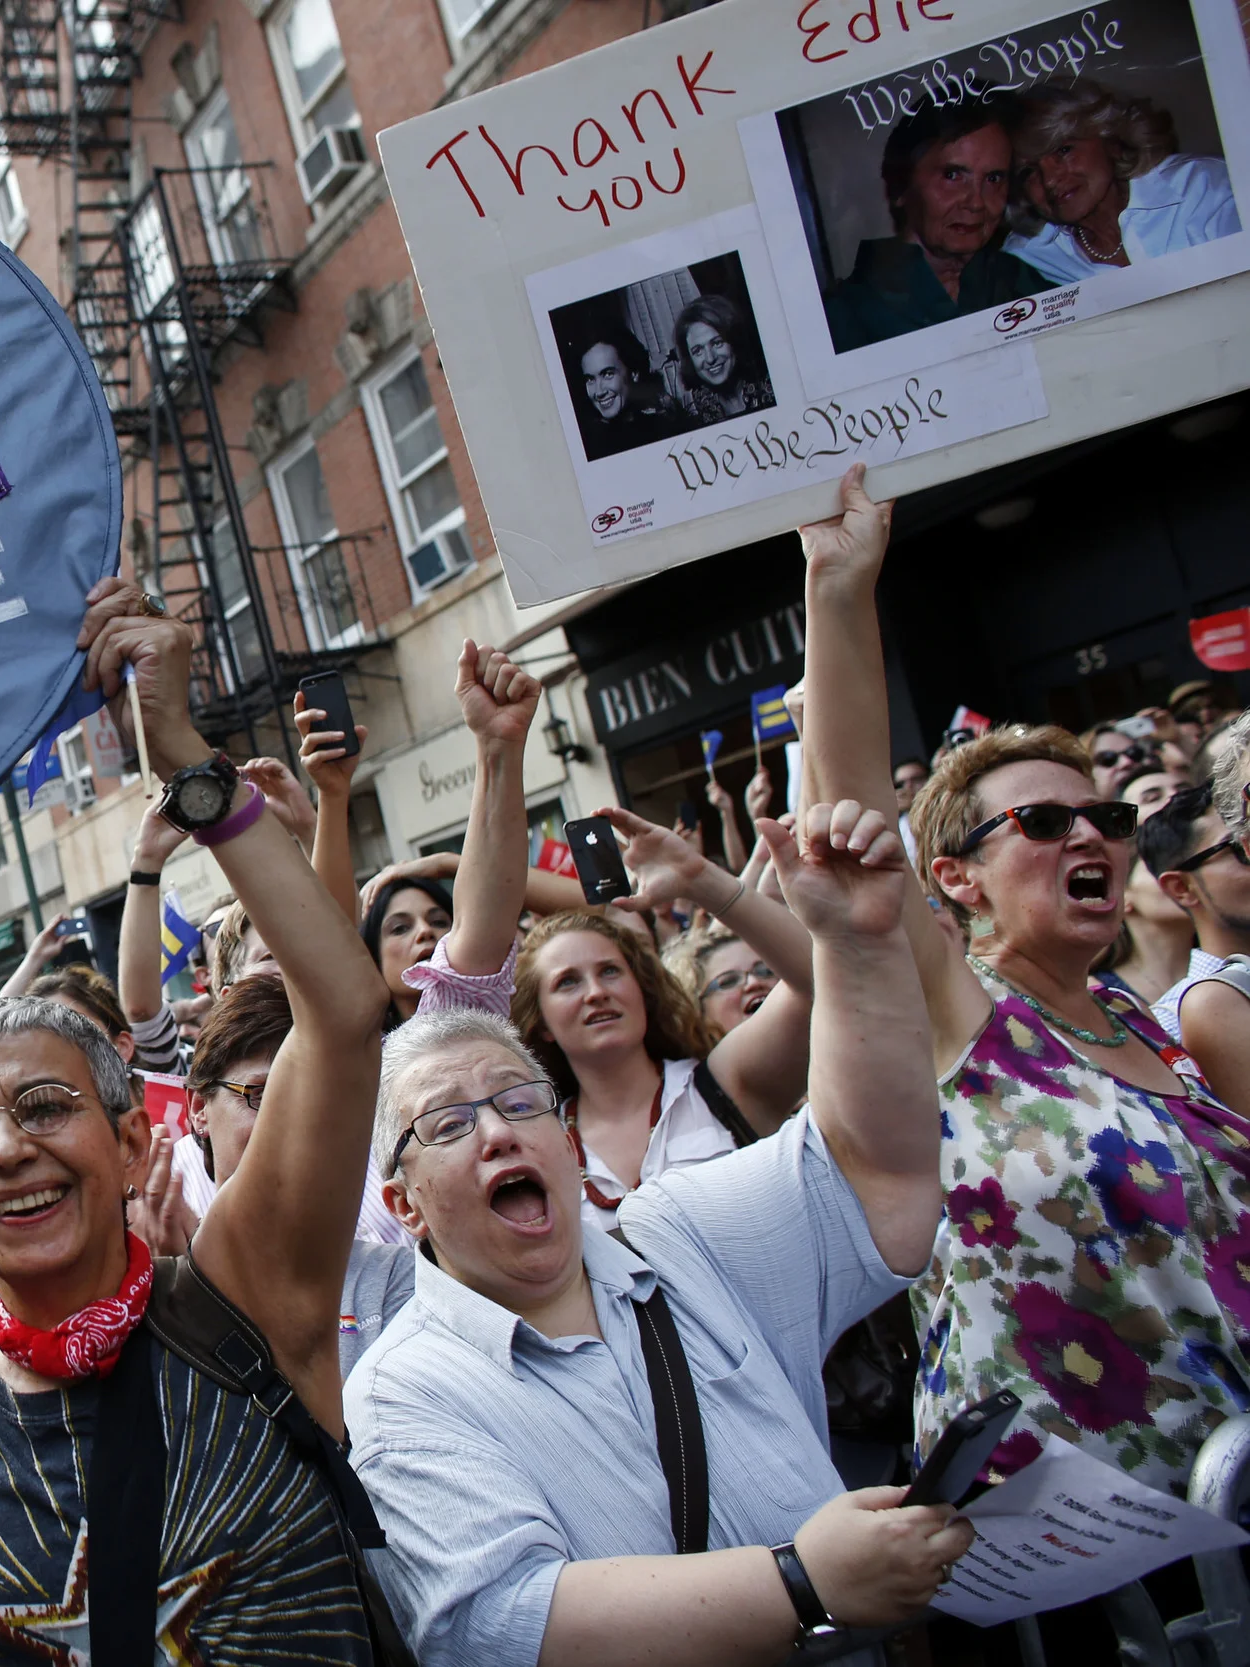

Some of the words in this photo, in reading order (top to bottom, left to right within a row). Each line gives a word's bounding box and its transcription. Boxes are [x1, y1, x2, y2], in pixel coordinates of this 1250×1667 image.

[842, 75, 924, 139] We
[920, 59, 988, 111] the
[979, 11, 1124, 105] People
[426, 51, 736, 217] Thank
[1041, 287, 1080, 305] marriage
[1043, 298, 1076, 313] equality
[1045, 310, 1061, 320] usa
[664, 434, 747, 499] We
[744, 421, 812, 473] the
[803, 378, 948, 468] People
[627, 498, 654, 512] marriage
[628, 507, 652, 518] equality
[1075, 644, 1108, 675] 35
[600, 654, 692, 732] BIEN
